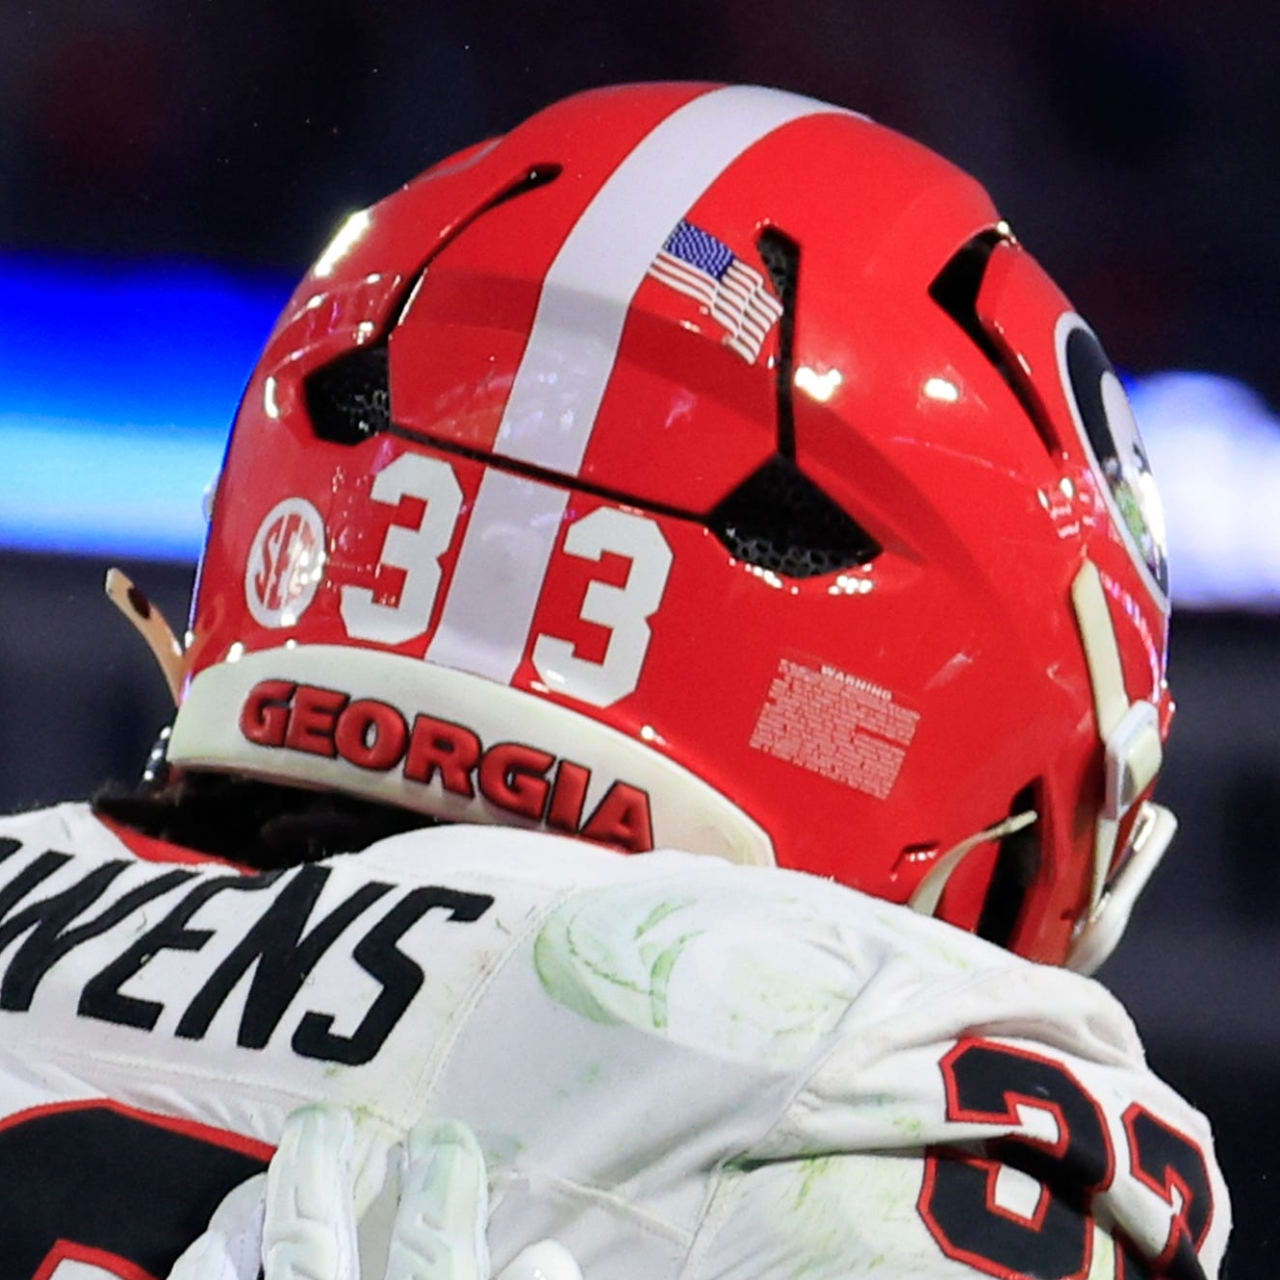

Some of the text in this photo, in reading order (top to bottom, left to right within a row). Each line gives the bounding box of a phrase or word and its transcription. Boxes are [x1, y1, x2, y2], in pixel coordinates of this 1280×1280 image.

[339, 451, 674, 708] 33
[239, 679, 654, 854] GEORGIA
[820, 663, 893, 702] WARNING
